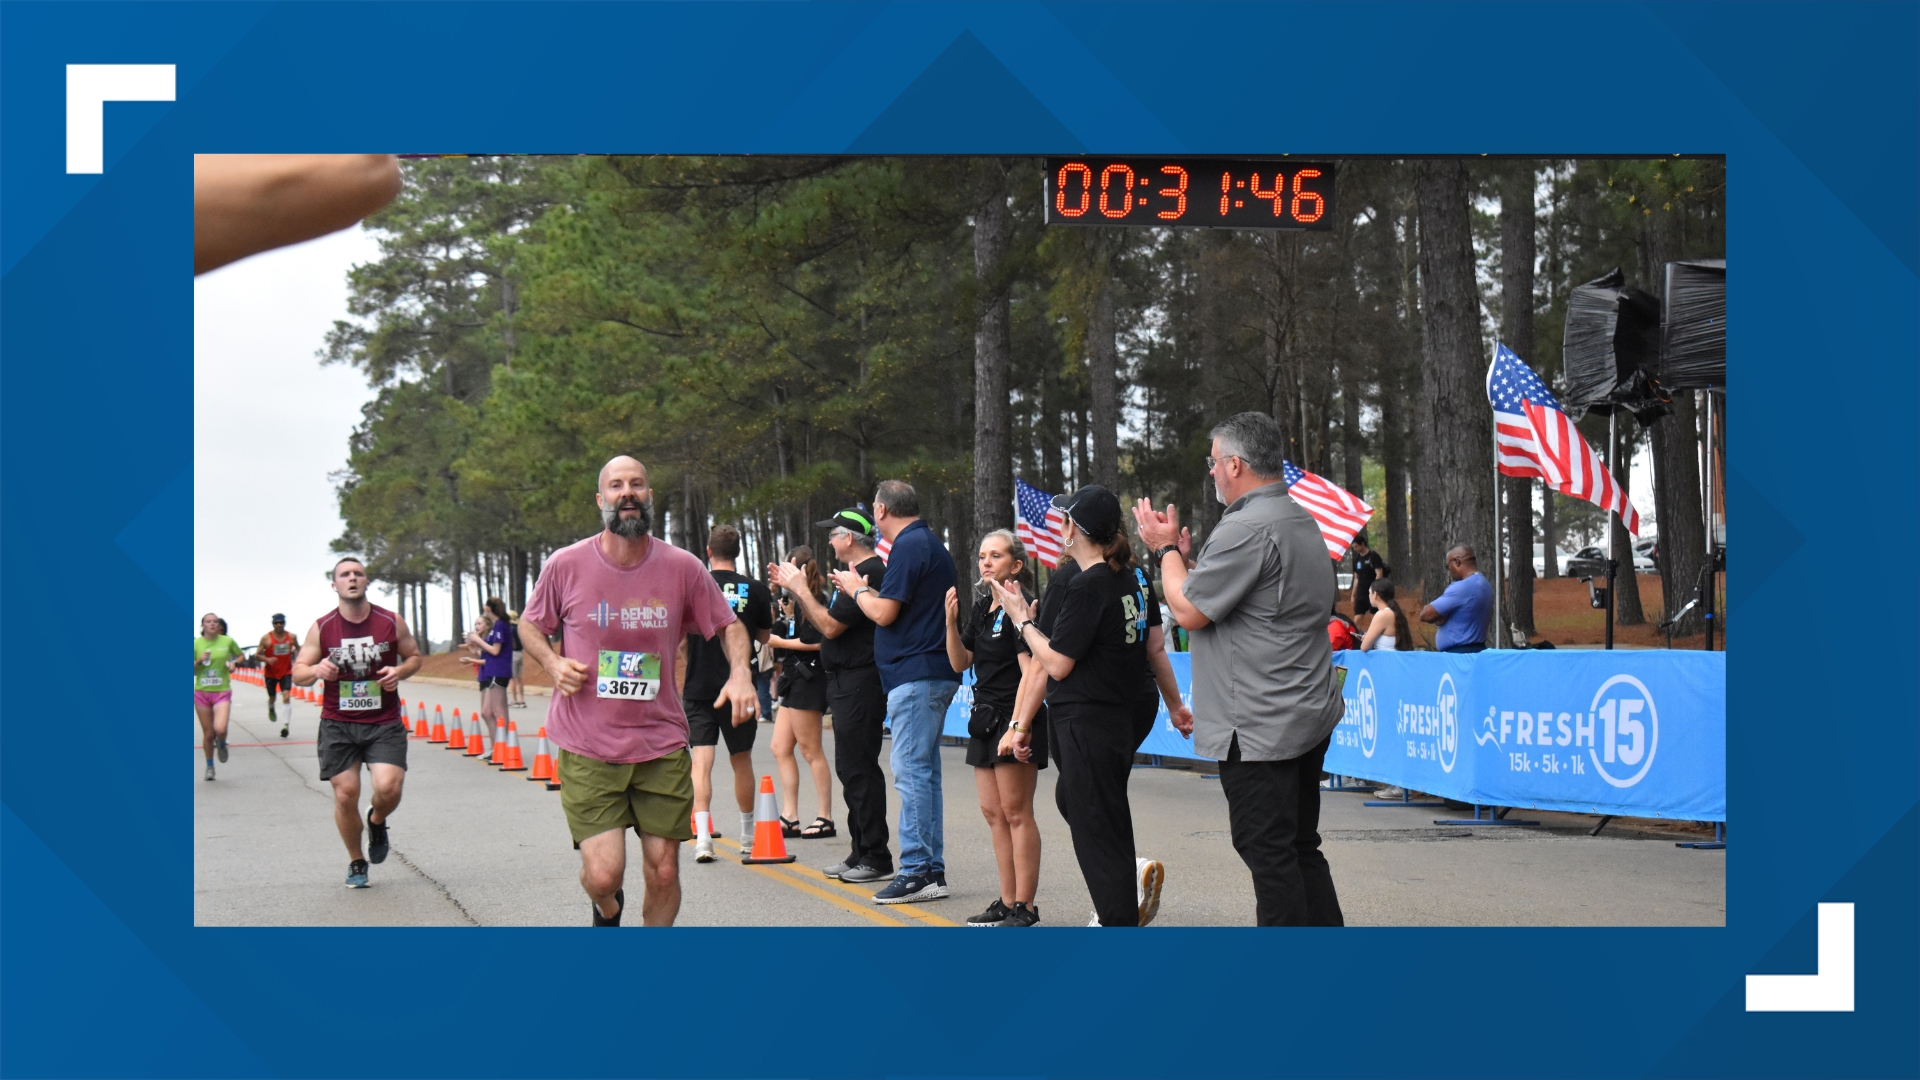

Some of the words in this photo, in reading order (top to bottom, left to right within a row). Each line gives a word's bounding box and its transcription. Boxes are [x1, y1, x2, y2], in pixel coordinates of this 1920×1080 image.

[621, 606, 668, 620] BEHIND
[621, 621, 638, 629] THE
[641, 619, 668, 628] WALLS
[620, 654, 643, 671] 5K
[353, 683, 367, 694] 5K
[609, 680, 648, 696] 3677
[348, 699, 373, 708] 5006
[1339, 698, 1360, 726] ESH
[1359, 687, 1374, 740] 15
[1403, 703, 1440, 737] FRESH
[1440, 693, 1455, 753] 15
[1500, 710, 1595, 747] FRESH
[1599, 698, 1645, 766] 15
[1407, 740, 1417, 758] 15k
[1420, 741, 1428, 760] 5k
[1430, 743, 1437, 761] 1k
[1509, 752, 1532, 773] 15k
[1541, 753, 1560, 774] 5k
[1570, 754, 1585, 775] 1k
